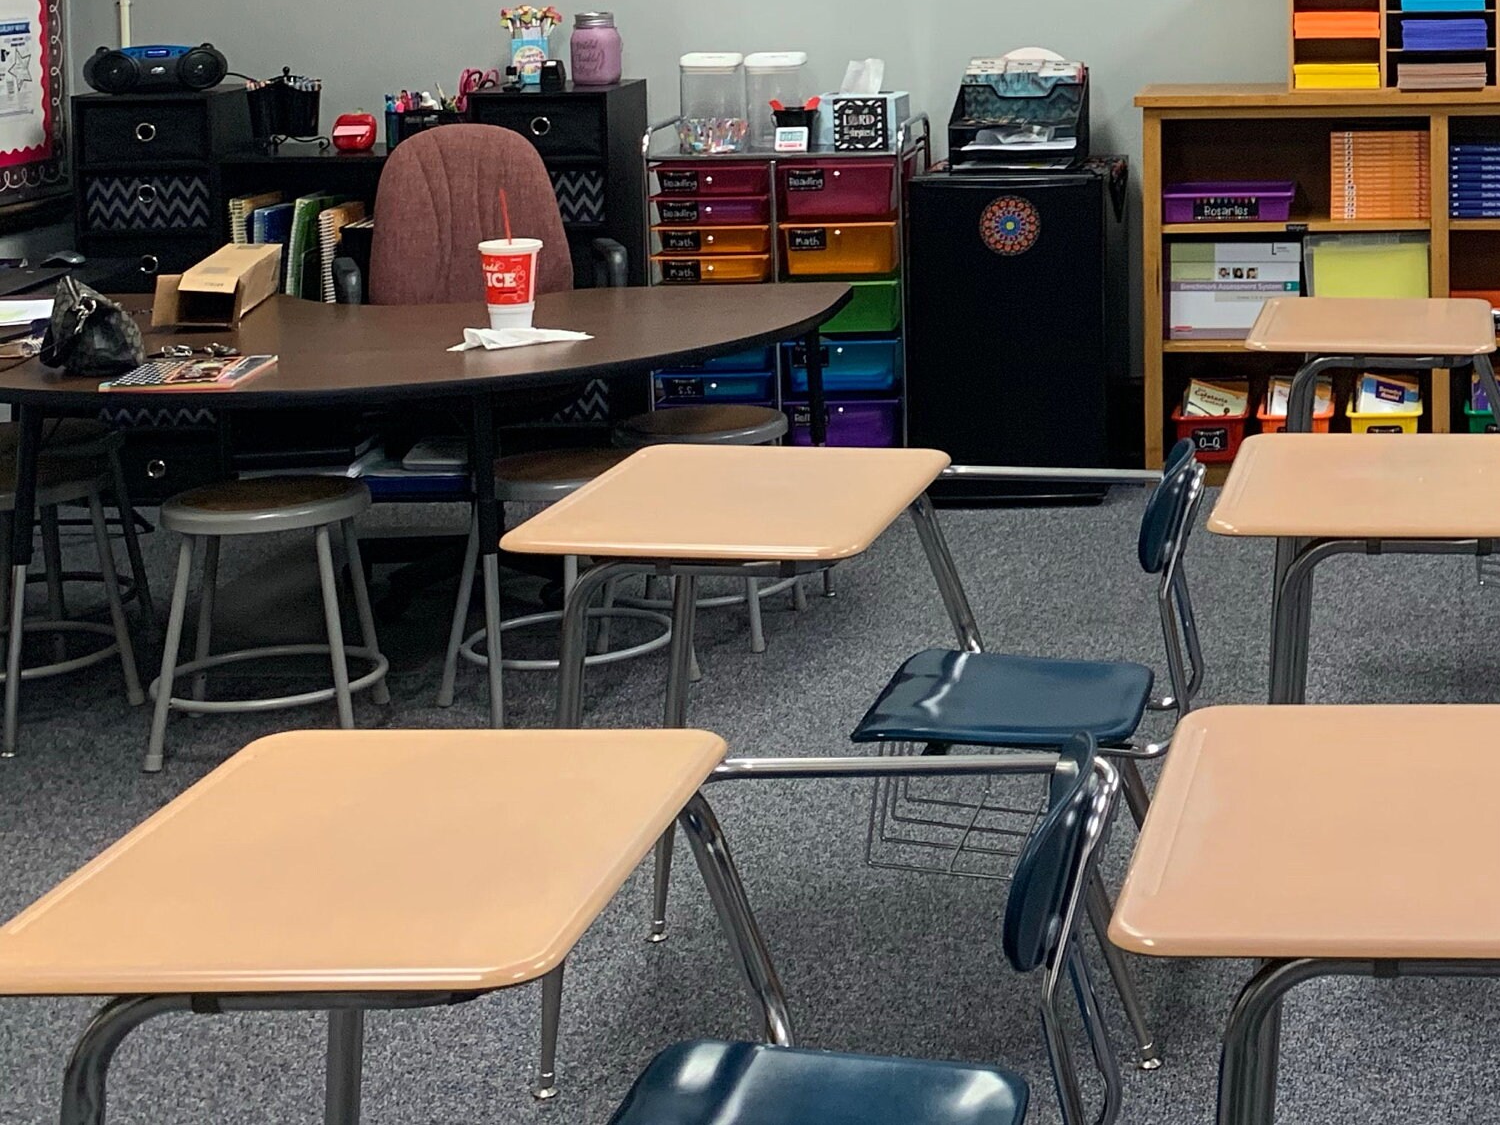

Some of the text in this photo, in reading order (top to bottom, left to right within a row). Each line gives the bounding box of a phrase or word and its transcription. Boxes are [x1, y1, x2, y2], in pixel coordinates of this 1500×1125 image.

[663, 179, 697, 190] Reading
[789, 177, 823, 188] Reading
[663, 209, 697, 220] Reading
[1204, 206, 1248, 216] Rosaries
[670, 238, 694, 247] Math
[796, 237, 820, 247] Math
[670, 268, 694, 277] Math
[486, 272, 517, 288] ICE
[1257, 283, 1283, 292] System
